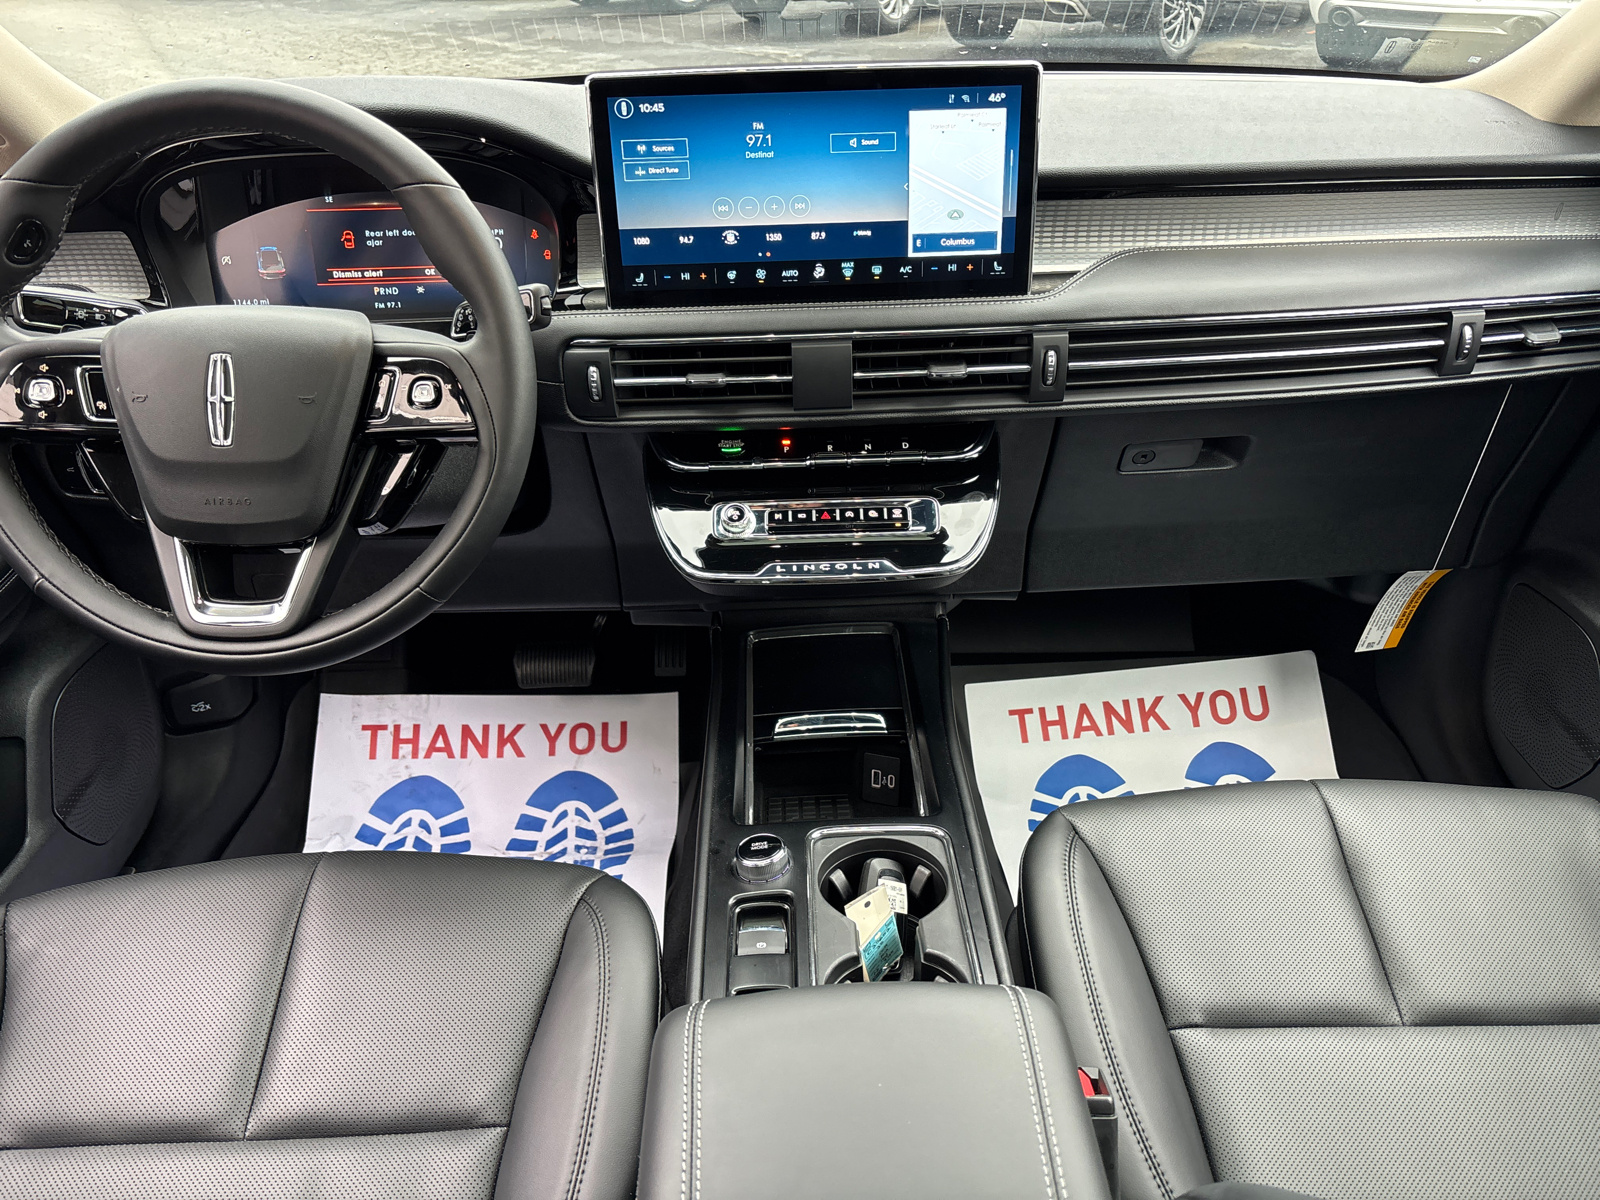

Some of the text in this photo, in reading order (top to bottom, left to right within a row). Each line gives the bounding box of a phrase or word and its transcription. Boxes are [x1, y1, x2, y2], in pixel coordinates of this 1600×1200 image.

[639, 103, 665, 113] 10:45
[752, 122, 764, 130] FM
[746, 133, 772, 147] 97.1
[745, 150, 774, 159] Destinat
[679, 235, 694, 244] 94.7
[766, 233, 782, 241] 1350
[811, 231, 826, 240] 87.9
[366, 239, 383, 247] ajar
[940, 238, 975, 246] Columbus
[899, 265, 912, 273] A/C
[947, 263, 957, 272] HI
[332, 270, 362, 278] Dismiss
[363, 269, 383, 277] alert
[680, 272, 690, 280] HI
[386, 301, 401, 309] 97.1
[204, 497, 252, 506] AIRBAG
[776, 562, 880, 573] LINCOLN
[1008, 685, 1270, 744] THANK YOU
[361, 721, 628, 760] THANK YOU
